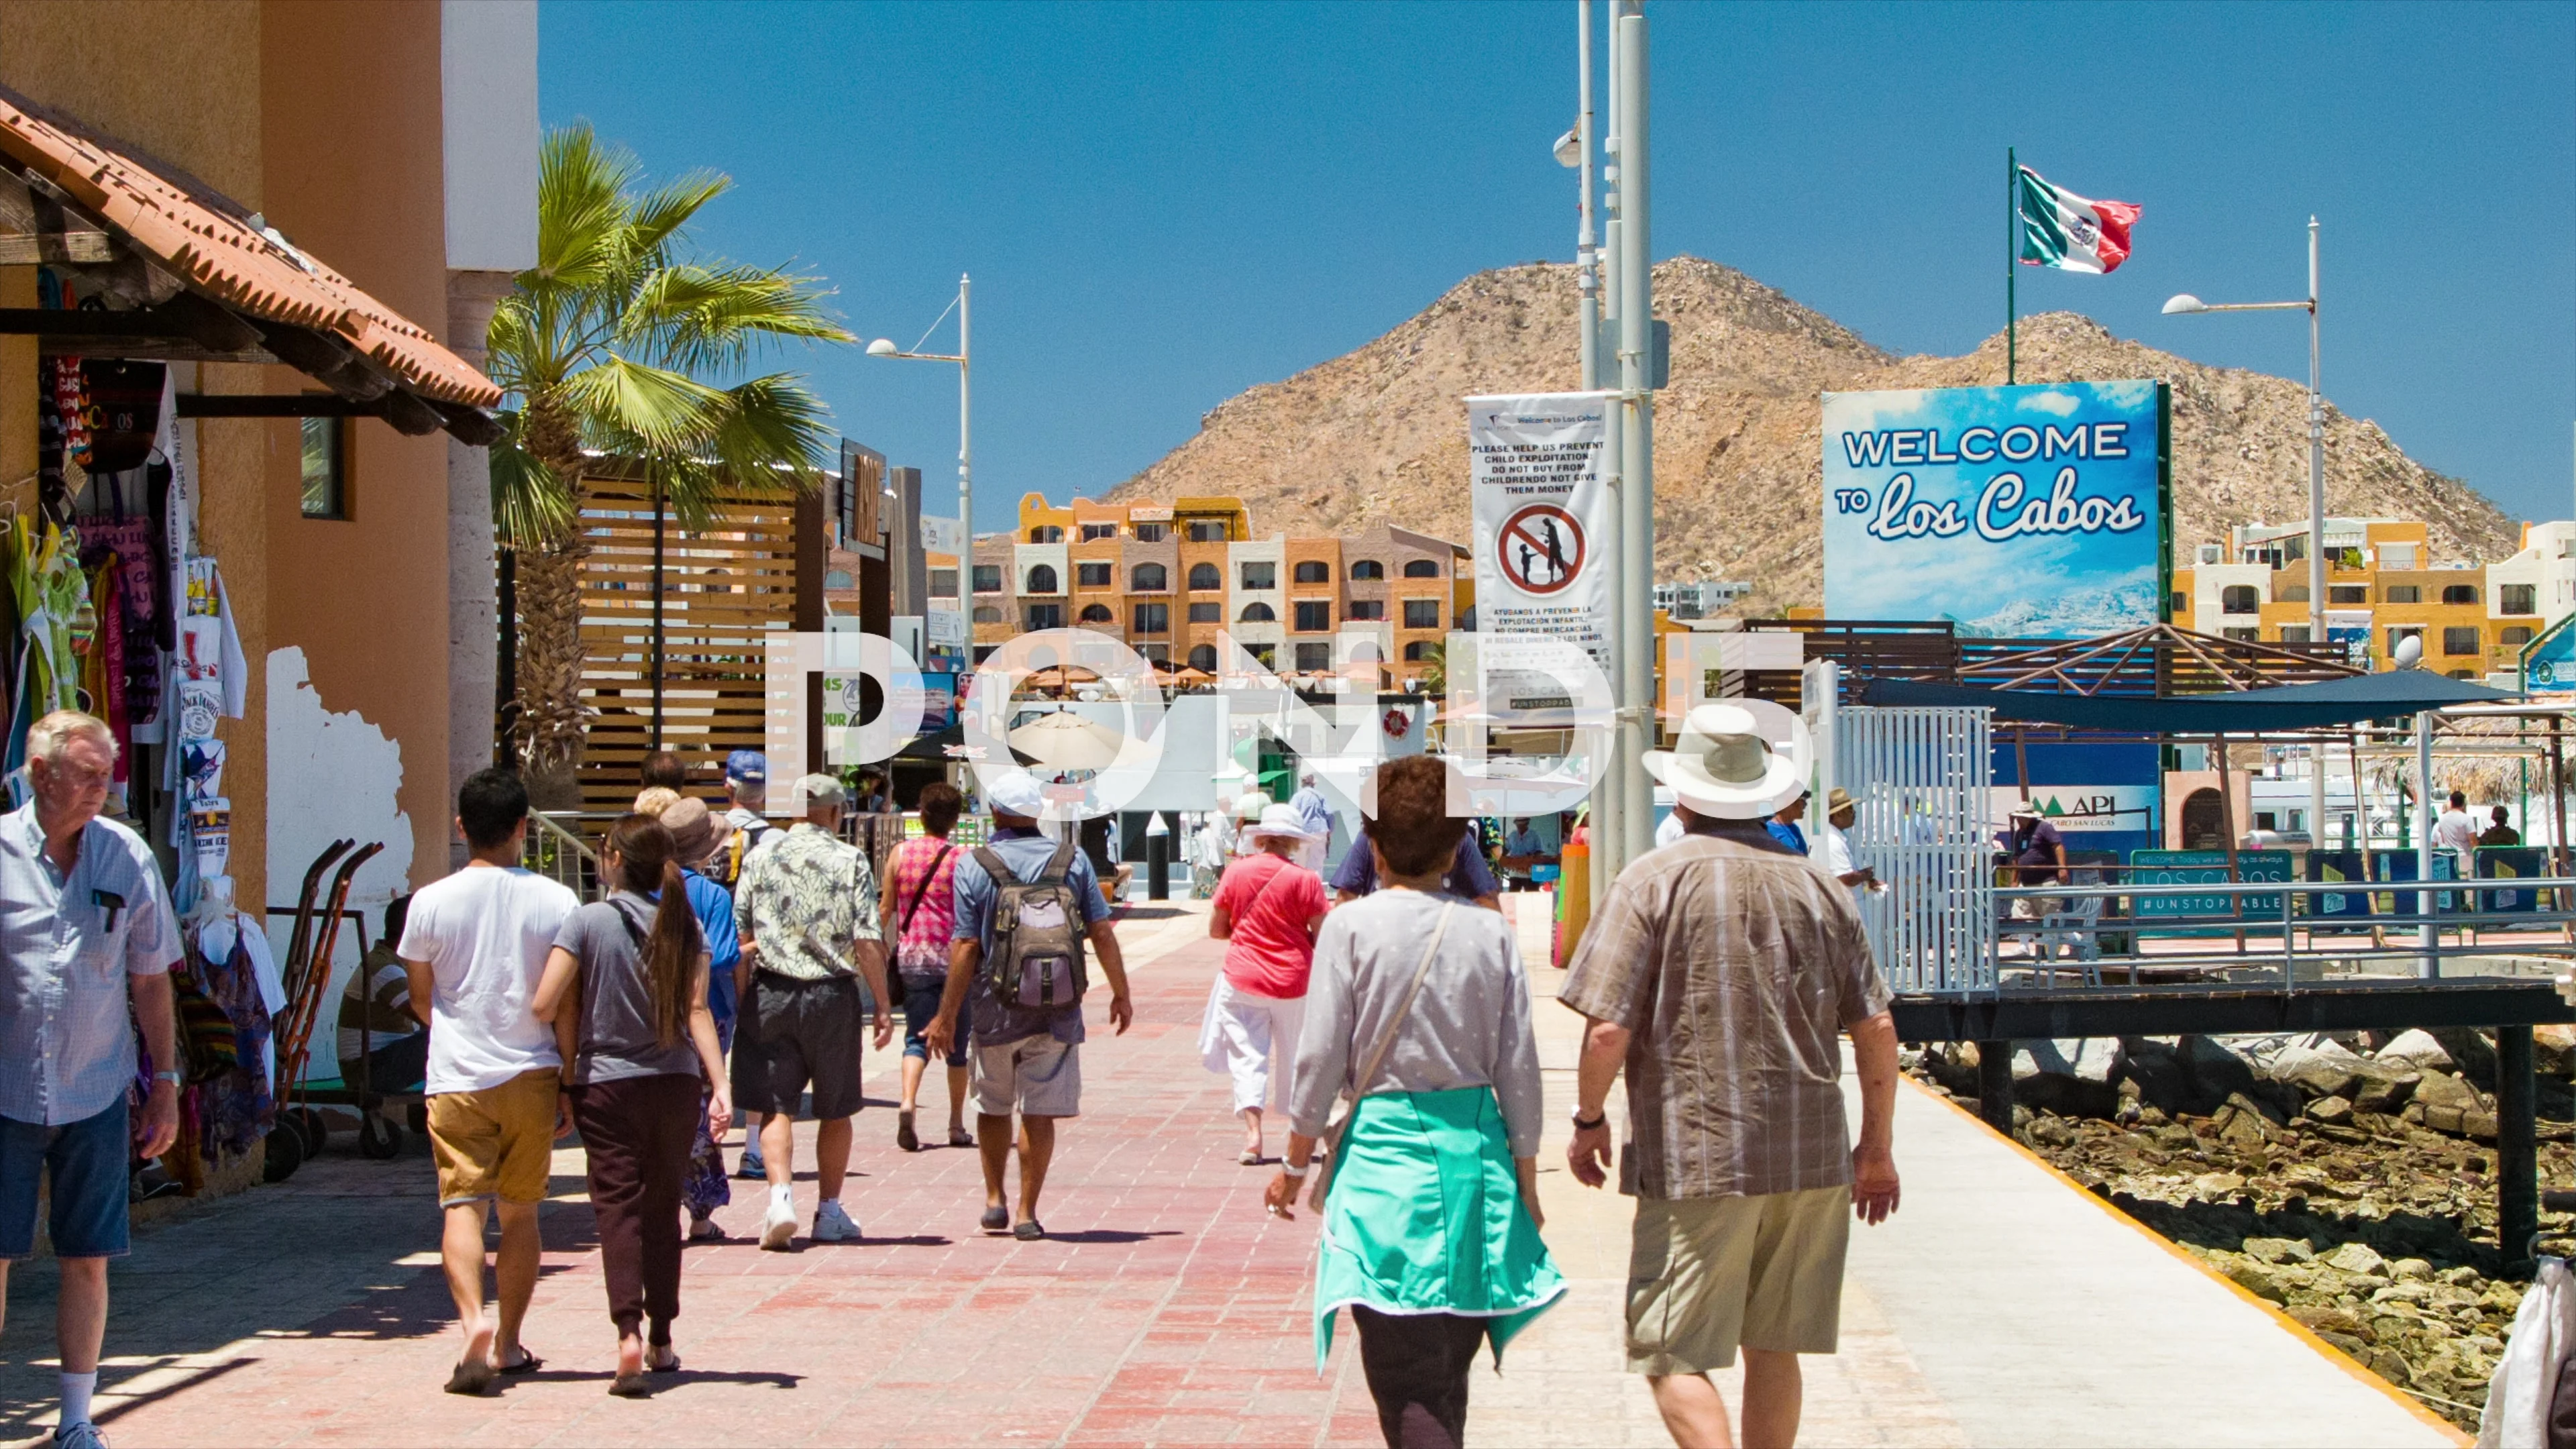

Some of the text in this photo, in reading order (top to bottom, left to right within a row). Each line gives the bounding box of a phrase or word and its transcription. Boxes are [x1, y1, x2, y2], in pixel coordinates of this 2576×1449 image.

[89, 405, 133, 429] Caos
[1472, 441, 1604, 453] PLEASE HELP US PREVENT
[1843, 423, 2129, 466] WELCOME
[1485, 455, 1515, 464] CHILD
[1492, 464, 1586, 474] DO NOT BUY FROM
[1481, 473, 1597, 484] CHILDRENDO NOT GIVE
[1505, 485, 1574, 494] THEM MONEY
[1835, 489, 1870, 513] TO
[1974, 466, 2145, 542] Cabos
[2072, 796, 2115, 816] API
[2052, 819, 2072, 827] CABO
[2144, 898, 2281, 909] #UNSTOPABLE
